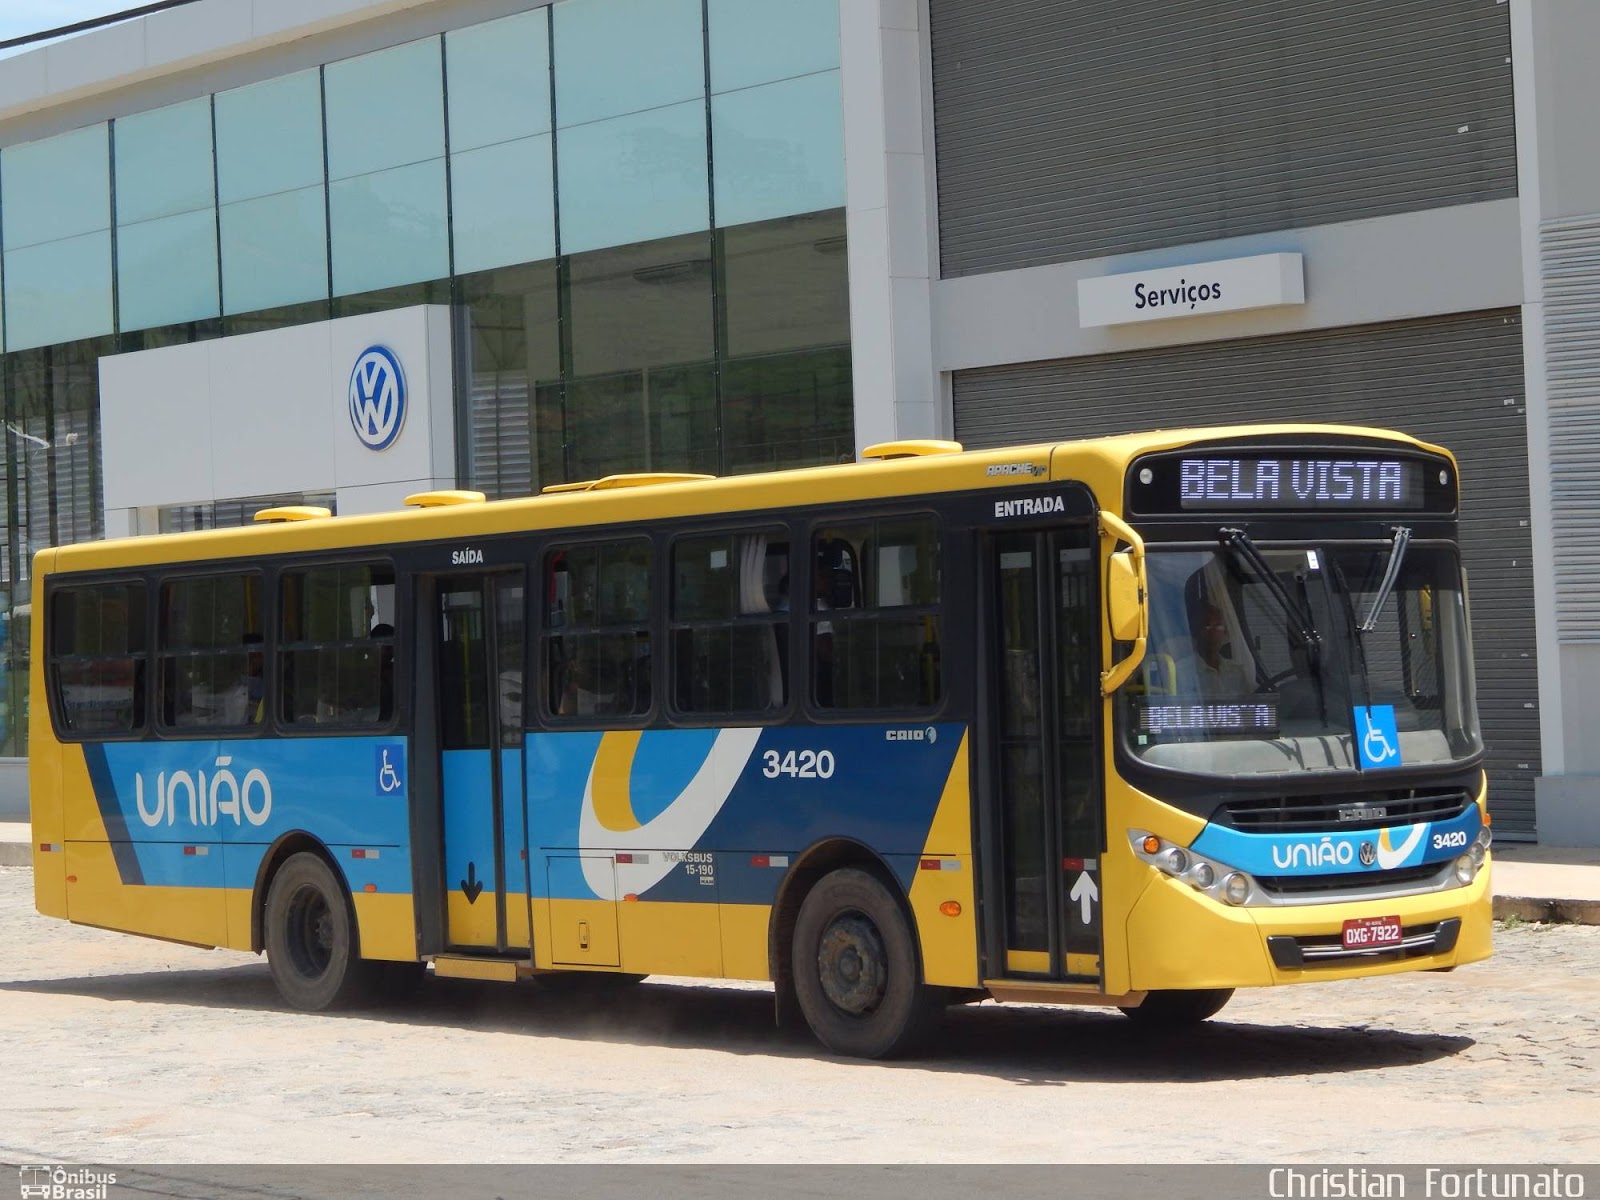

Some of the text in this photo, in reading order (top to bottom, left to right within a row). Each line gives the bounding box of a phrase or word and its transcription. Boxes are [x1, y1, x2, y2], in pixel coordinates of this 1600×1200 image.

[1134, 279, 1222, 309] Serviços
[986, 463, 1033, 476] APACHE
[1181, 460, 1401, 499] BELA VISTA
[994, 496, 1065, 518] ENTRADA
[451, 546, 484, 565] SAÍDA
[1148, 705, 1204, 728] BELA
[885, 730, 924, 741] CAIO
[762, 750, 835, 779] 3420
[136, 756, 272, 827] UNIÃO
[1433, 831, 1467, 850] 3420
[662, 852, 713, 863] VOLKSBUS
[1273, 837, 1353, 869] UNIÃO
